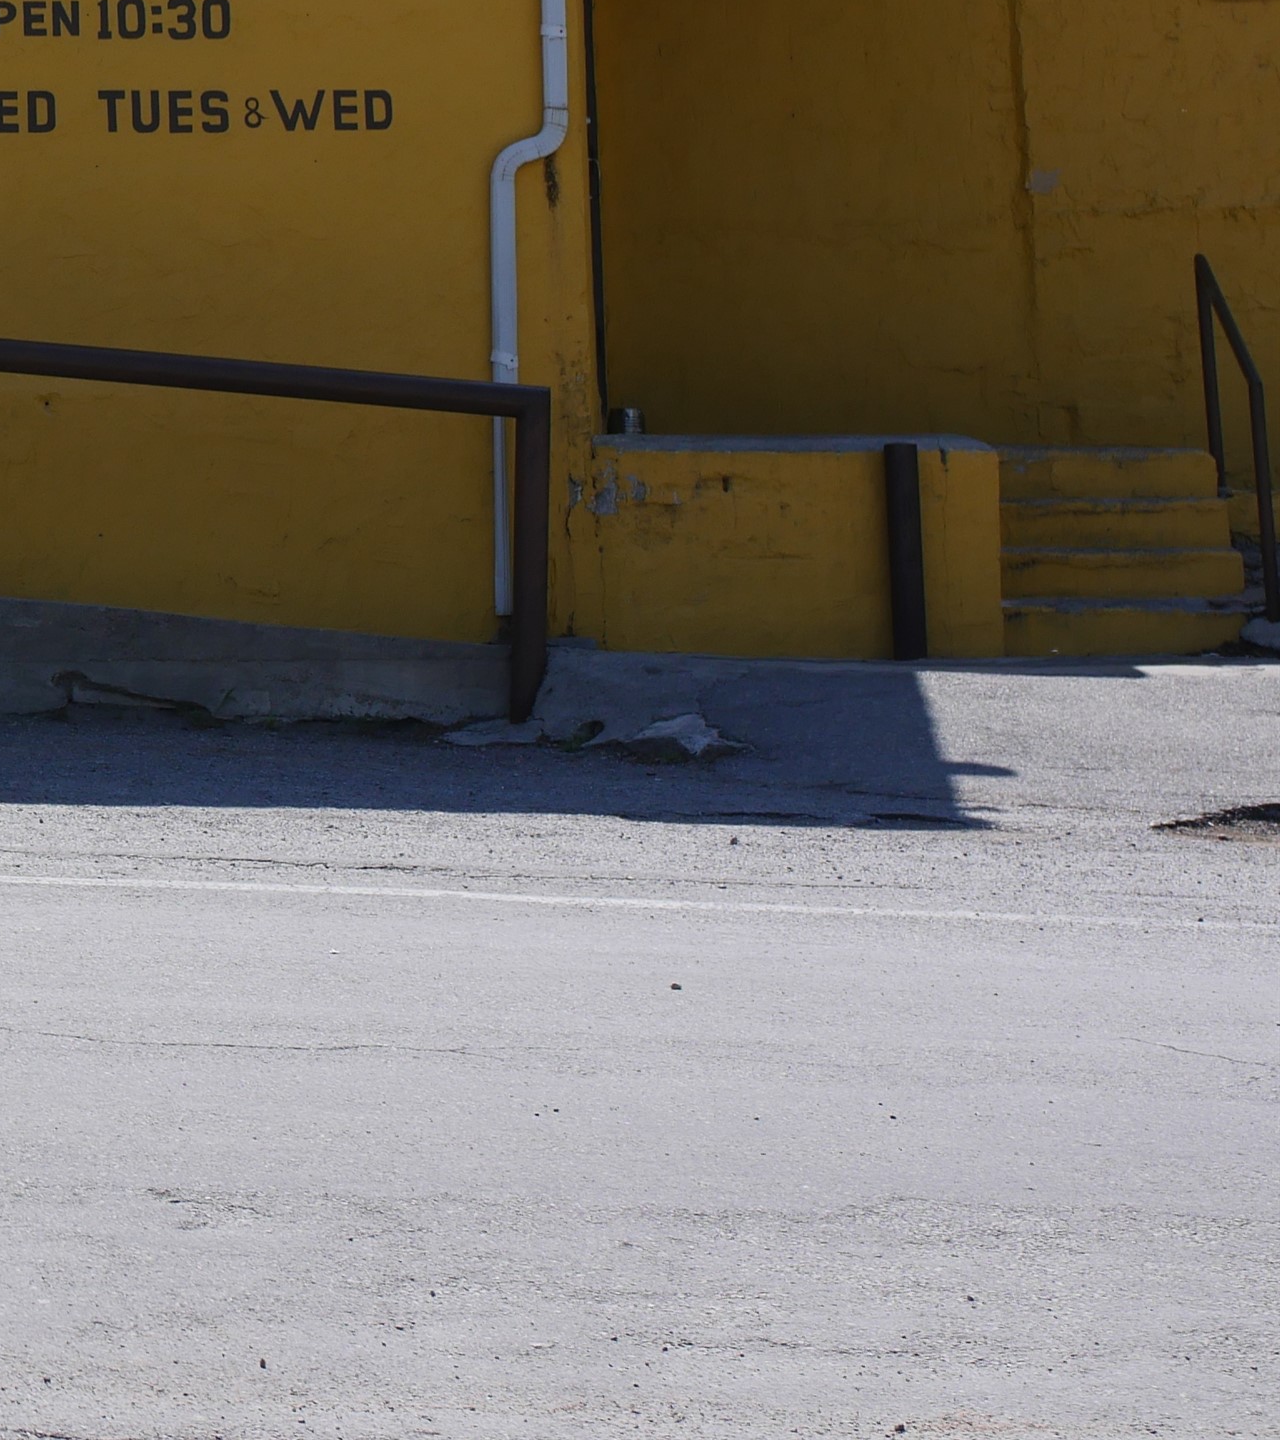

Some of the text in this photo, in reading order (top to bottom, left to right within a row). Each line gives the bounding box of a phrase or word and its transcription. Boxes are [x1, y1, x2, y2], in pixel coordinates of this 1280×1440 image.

[97, 89, 229, 133] TUES
[243, 96, 265, 129] &
[271, 89, 393, 132] WED
